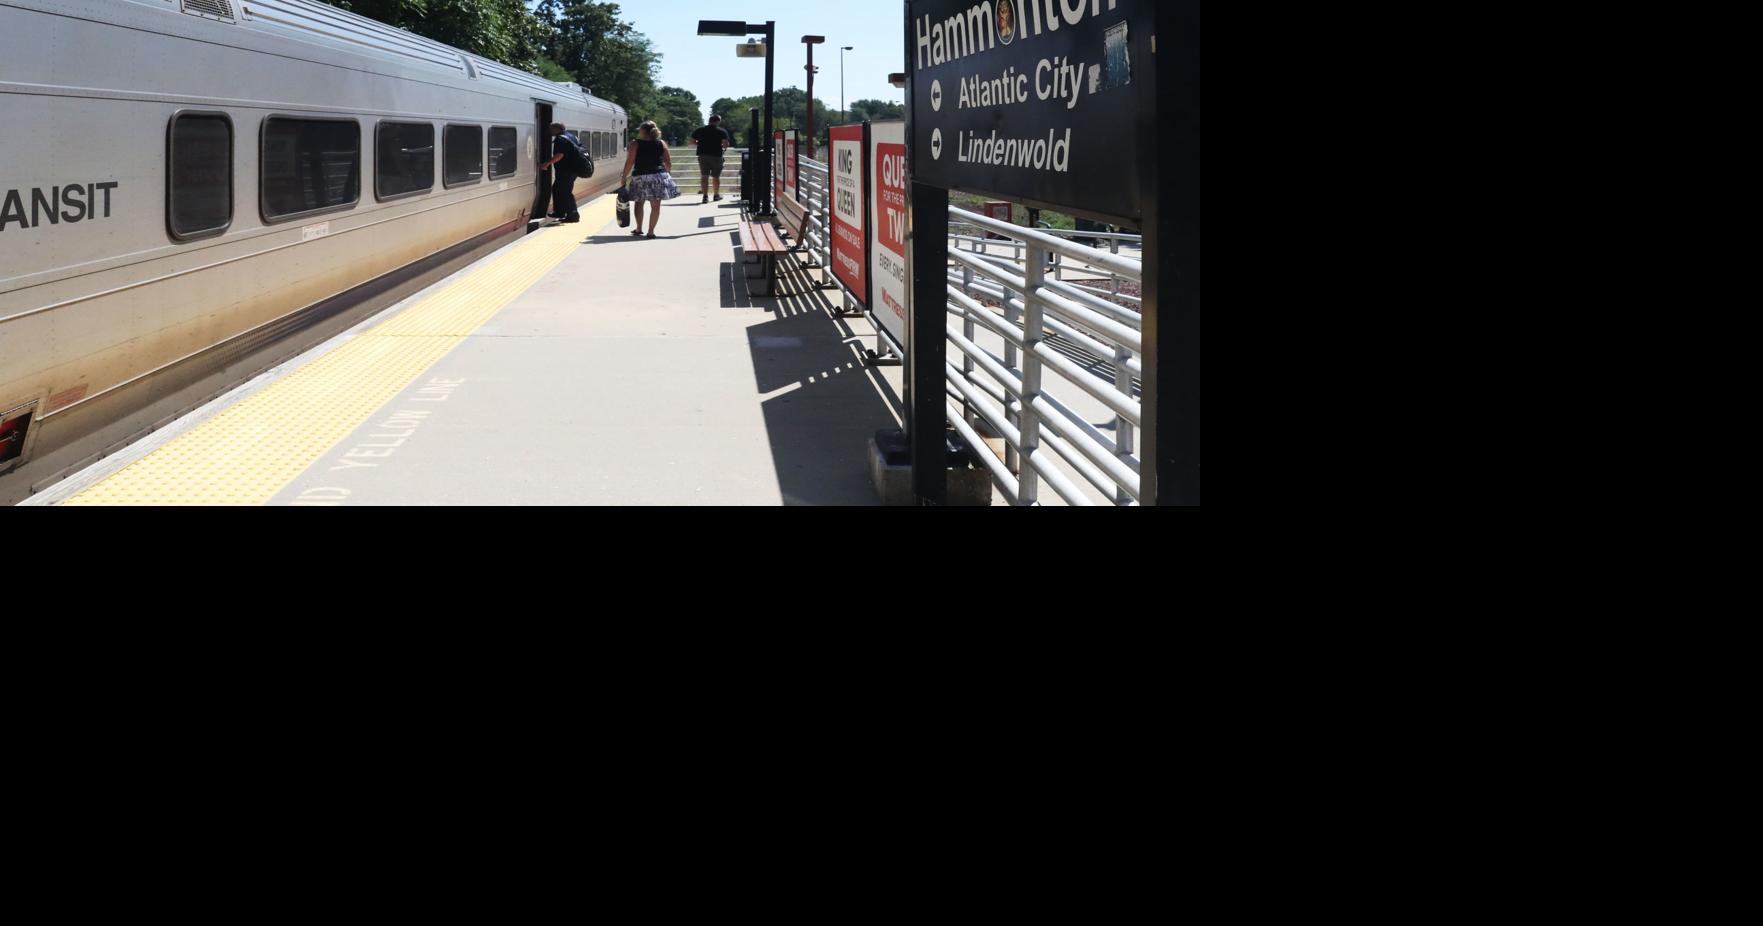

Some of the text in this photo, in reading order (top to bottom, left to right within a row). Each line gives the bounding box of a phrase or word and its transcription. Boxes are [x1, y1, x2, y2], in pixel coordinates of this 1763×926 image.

[958, 56, 1085, 109] Atlantic City
[838, 149, 853, 174] KING
[883, 154, 905, 189] QUE
[958, 128, 1071, 172] Lindenwold
[0, 181, 118, 231] ANSIT
[837, 187, 856, 218] QUEEN
[329, 410, 433, 472] YELLOW
[410, 377, 466, 401] LINE
